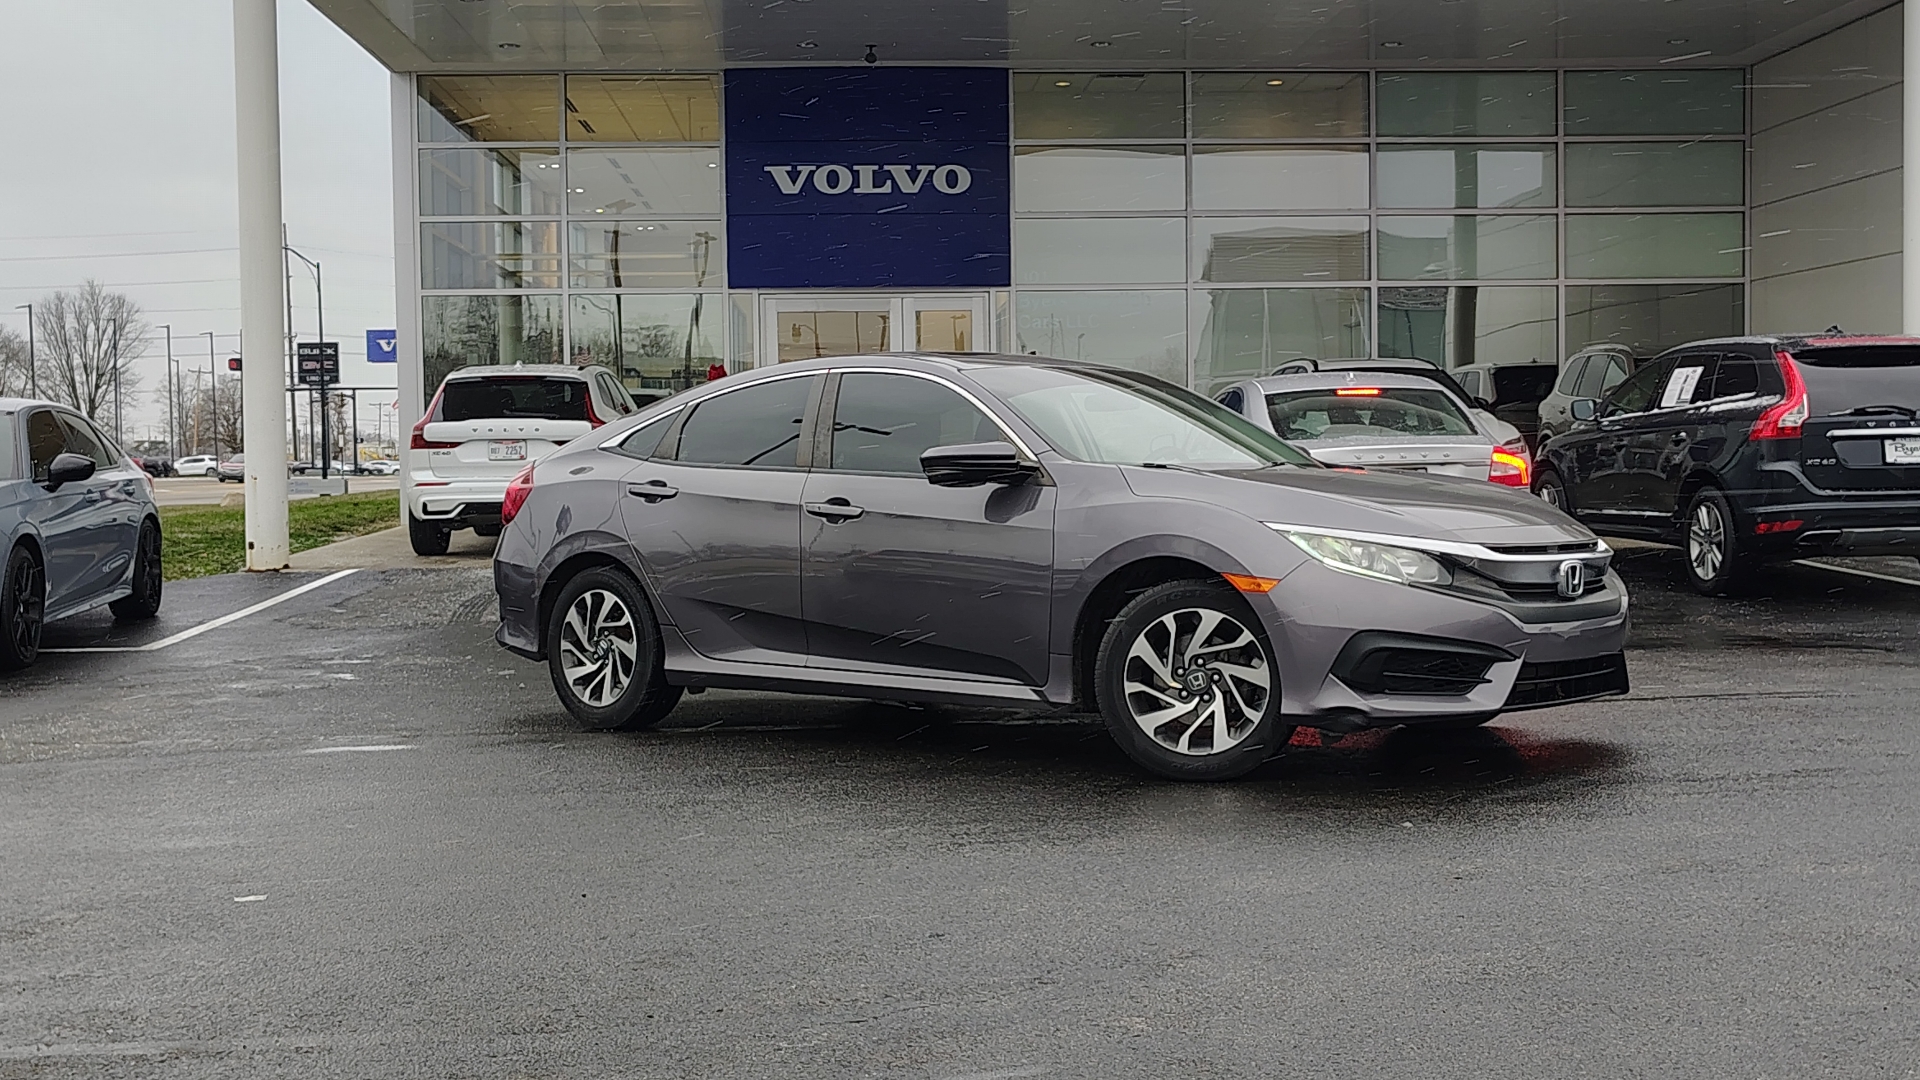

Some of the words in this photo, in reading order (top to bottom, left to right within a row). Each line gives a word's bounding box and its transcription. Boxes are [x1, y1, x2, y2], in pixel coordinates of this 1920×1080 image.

[763, 164, 972, 195] VOLVO
[1066, 314, 1100, 328] LLC
[1353, 452, 1451, 460] VOLVO
[1805, 458, 1837, 466] XC60
